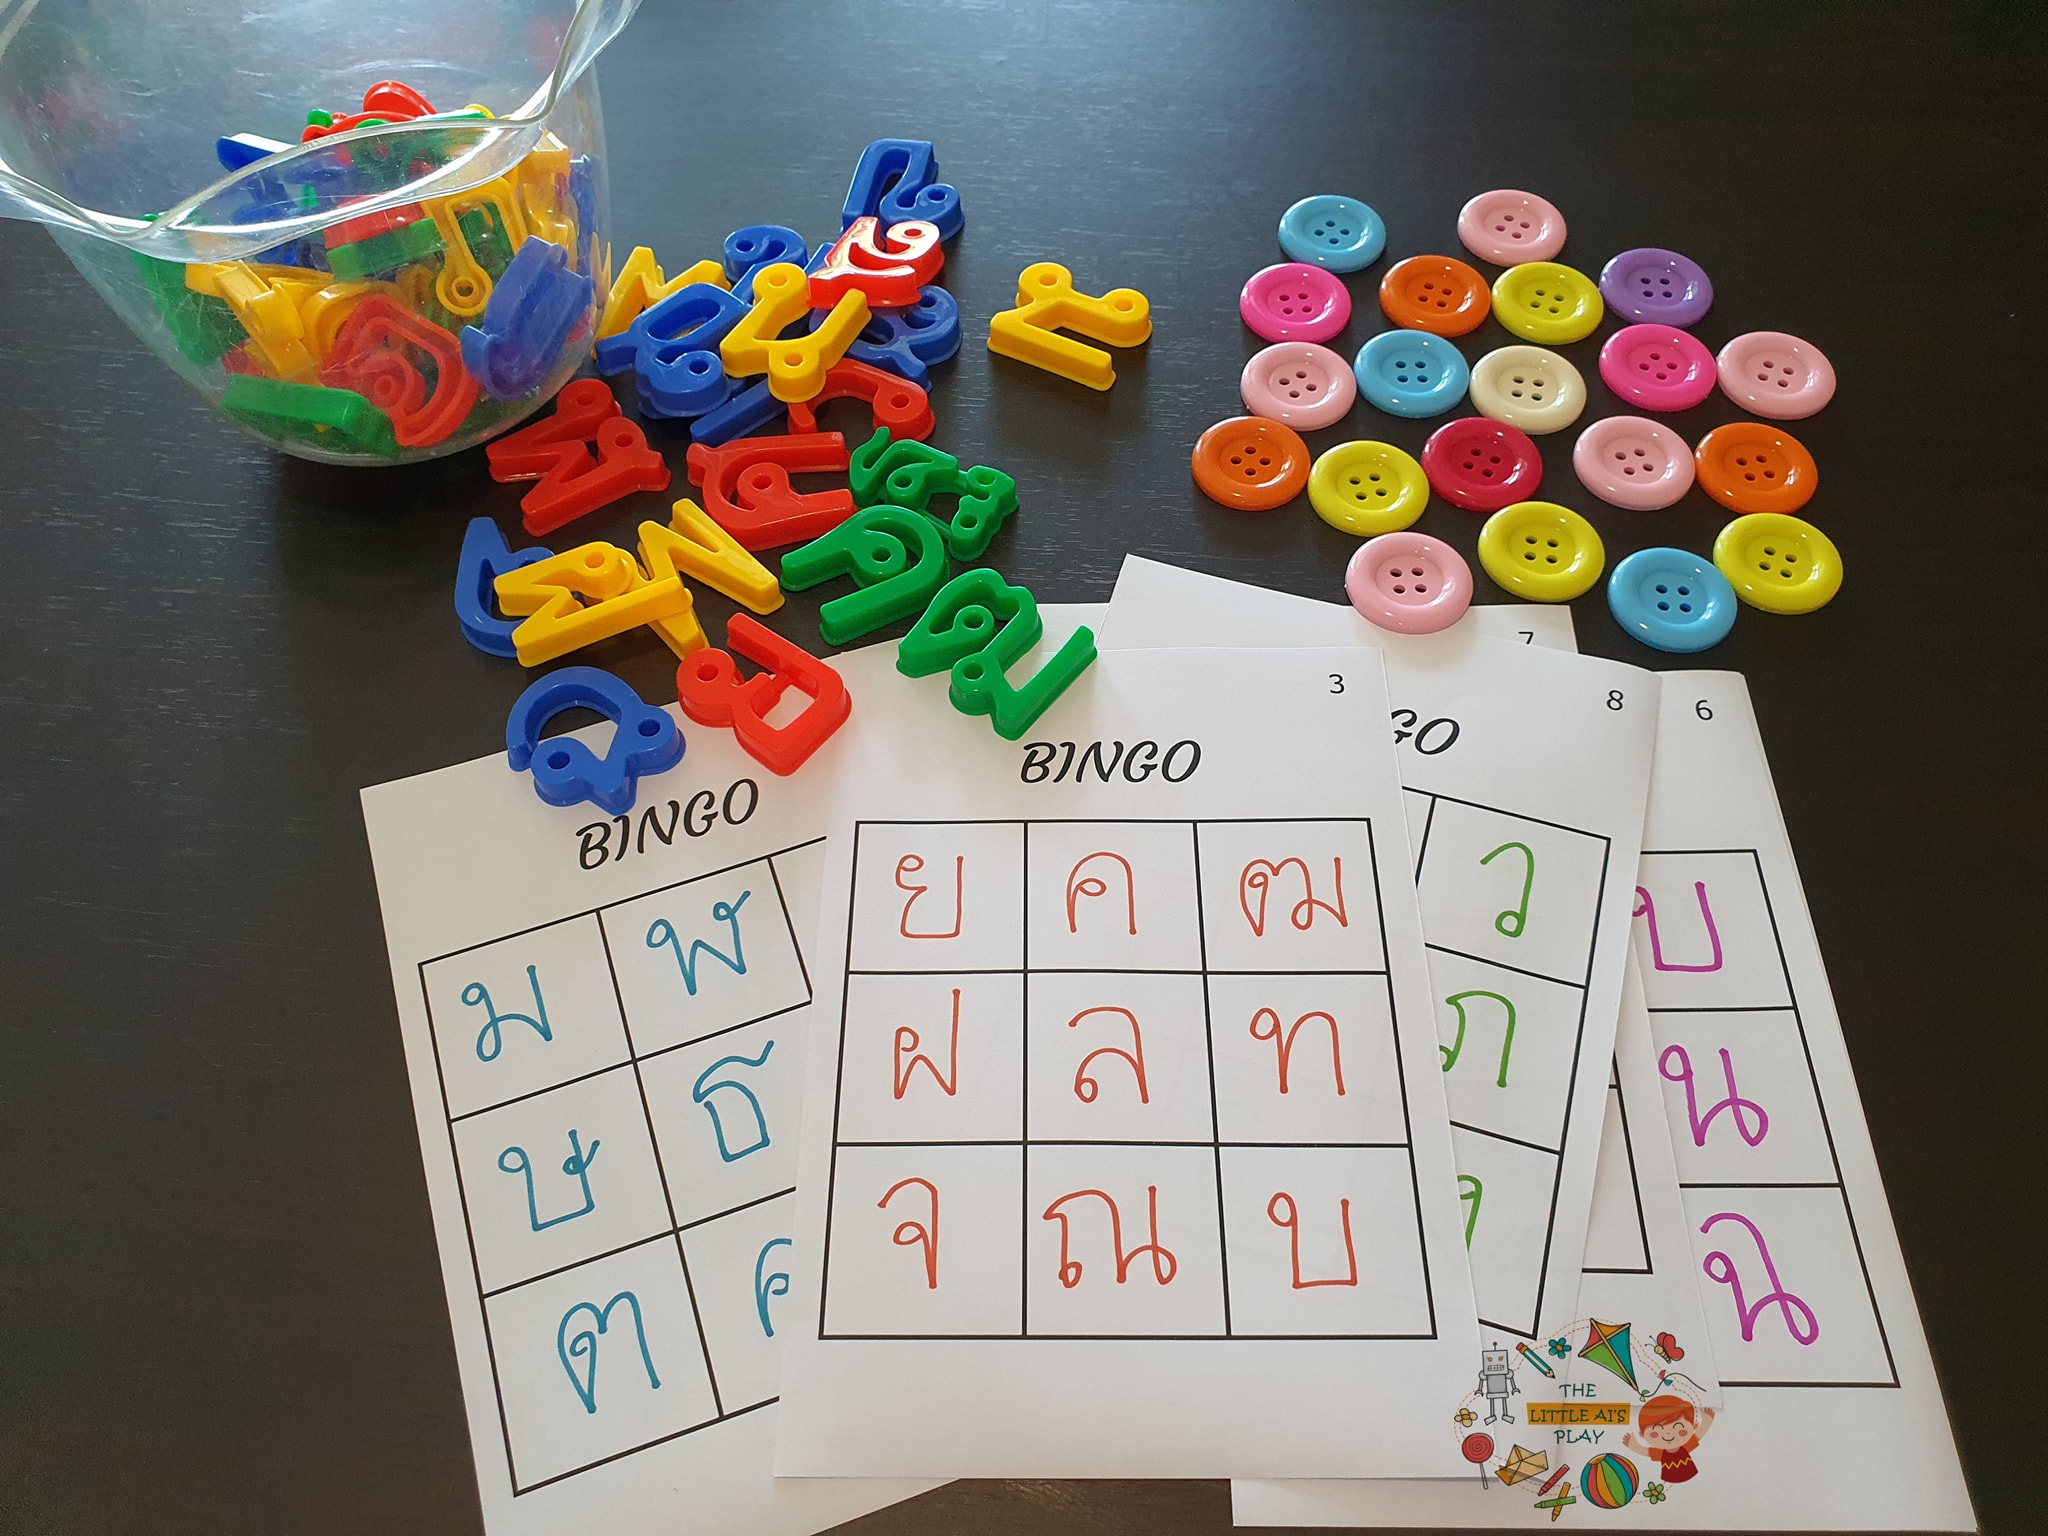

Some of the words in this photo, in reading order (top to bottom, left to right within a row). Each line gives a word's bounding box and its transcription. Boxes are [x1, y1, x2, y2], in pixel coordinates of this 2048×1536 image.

[1328, 673, 1345, 694] 3
[1606, 689, 1624, 711] 8
[1695, 699, 1713, 721] 6
[1019, 739, 1201, 784] BINGO
[575, 778, 759, 870] BINGO
[895, 854, 964, 939] ย
[1066, 851, 1137, 936] ค
[1239, 857, 1348, 937] ฒ
[1480, 842, 1535, 938] ว
[461, 964, 553, 1062] ม
[893, 988, 961, 1100] ฝ
[1068, 1006, 1150, 1104] ล
[1249, 1007, 1346, 1096] ท
[692, 1041, 774, 1163] ธ
[1658, 1045, 1769, 1147] น
[498, 1130, 600, 1232] ษ
[877, 1177, 939, 1290] จ
[1042, 1185, 1177, 1289] ณ
[1267, 1192, 1358, 1290] บ
[1700, 1212, 1819, 1346] ฉ
[557, 1291, 661, 1414] ต
